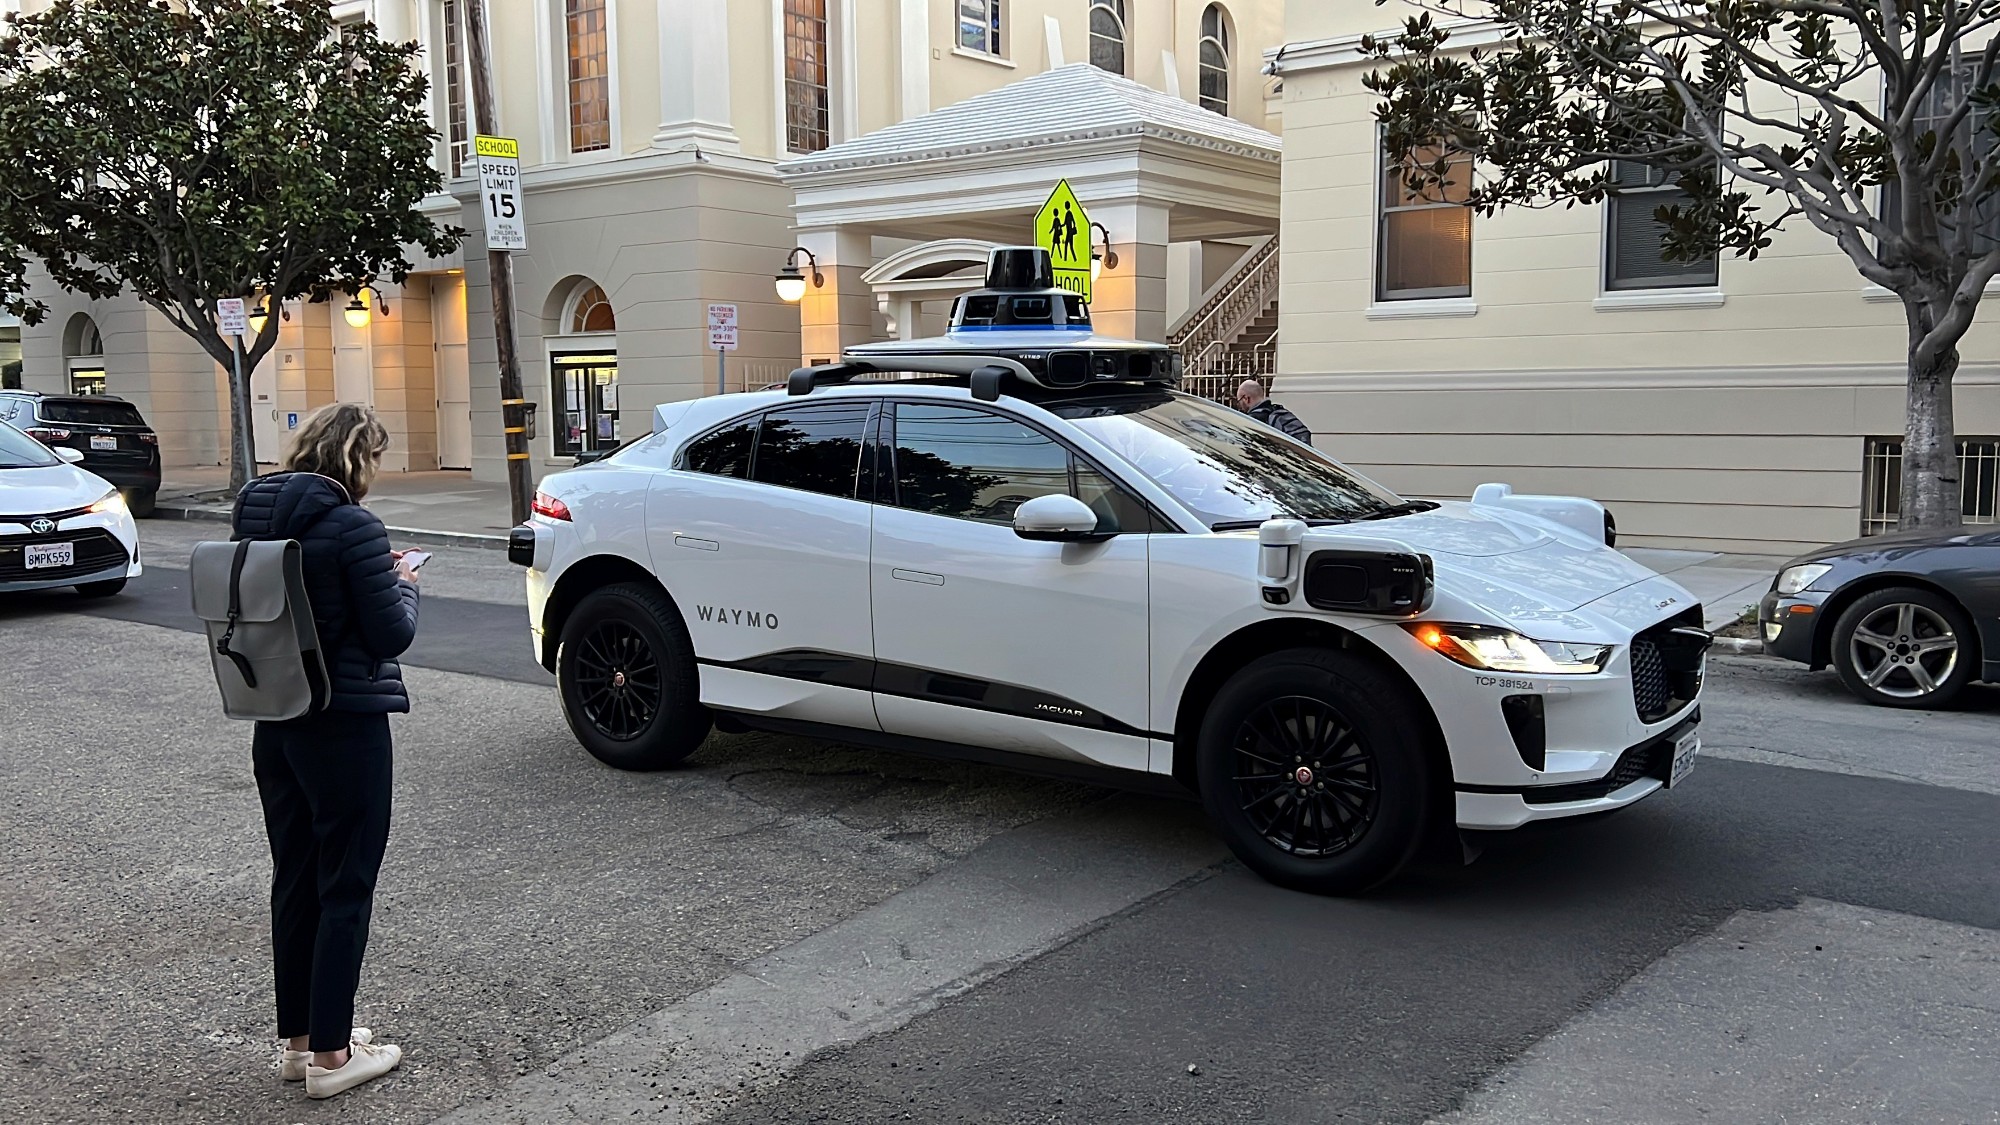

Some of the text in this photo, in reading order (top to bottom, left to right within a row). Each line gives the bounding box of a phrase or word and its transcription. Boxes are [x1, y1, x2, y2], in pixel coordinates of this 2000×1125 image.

[478, 140, 515, 154] SCHOOL
[482, 163, 517, 176] SPEED
[486, 178, 514, 190] LIMIT
[489, 193, 516, 218] 15
[1055, 275, 1088, 296] HOOL
[28, 551, 71, 566] 8MPK559
[696, 604, 779, 630] WAYMO
[1475, 676, 1534, 690] TCP 38152A
[1034, 703, 1083, 717] JAGUAR
